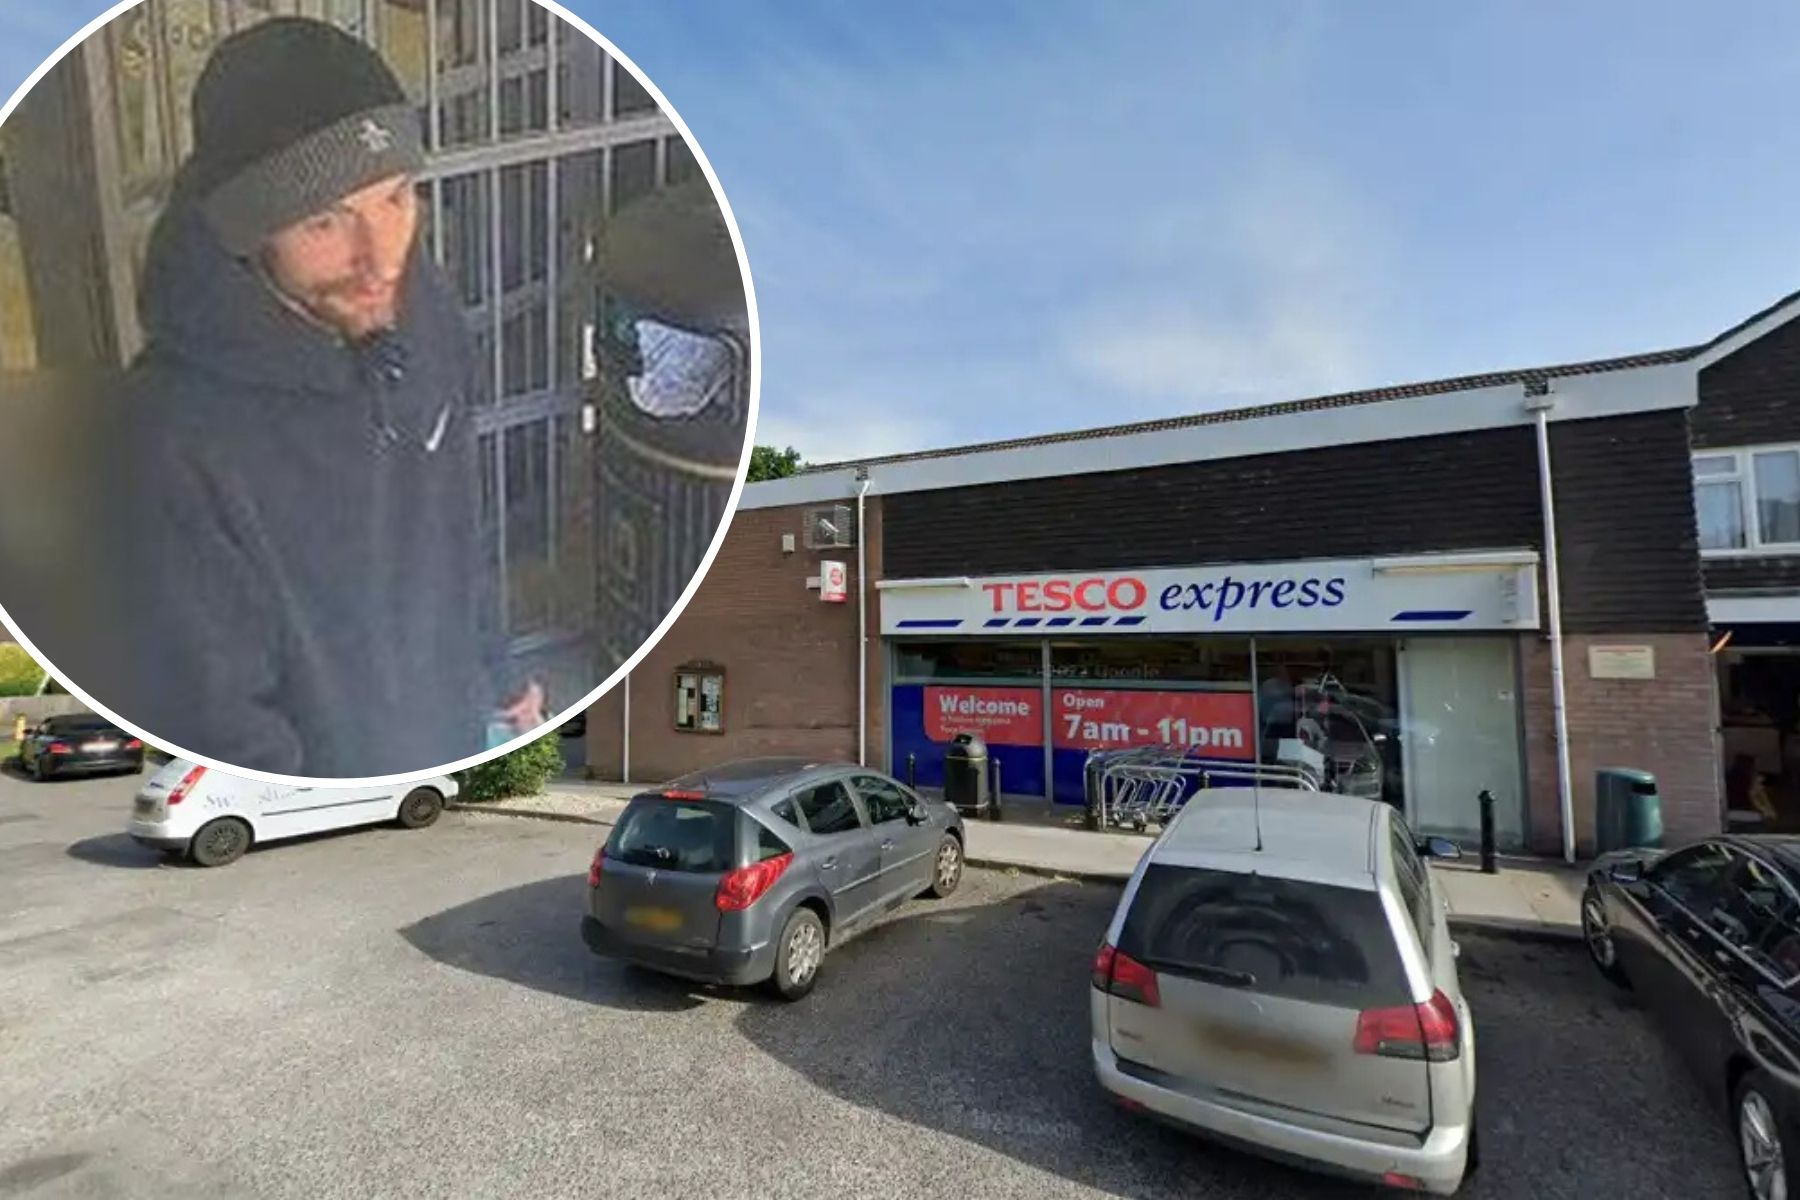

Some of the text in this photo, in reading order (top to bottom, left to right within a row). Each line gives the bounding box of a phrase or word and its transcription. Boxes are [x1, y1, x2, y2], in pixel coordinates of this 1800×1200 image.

[982, 576, 1345, 622] TESCO express
[939, 695, 1030, 716] Welcome
[1063, 693, 1105, 709] Open
[1063, 714, 1130, 741] 7am
[1157, 718, 1242, 747] 11pm
